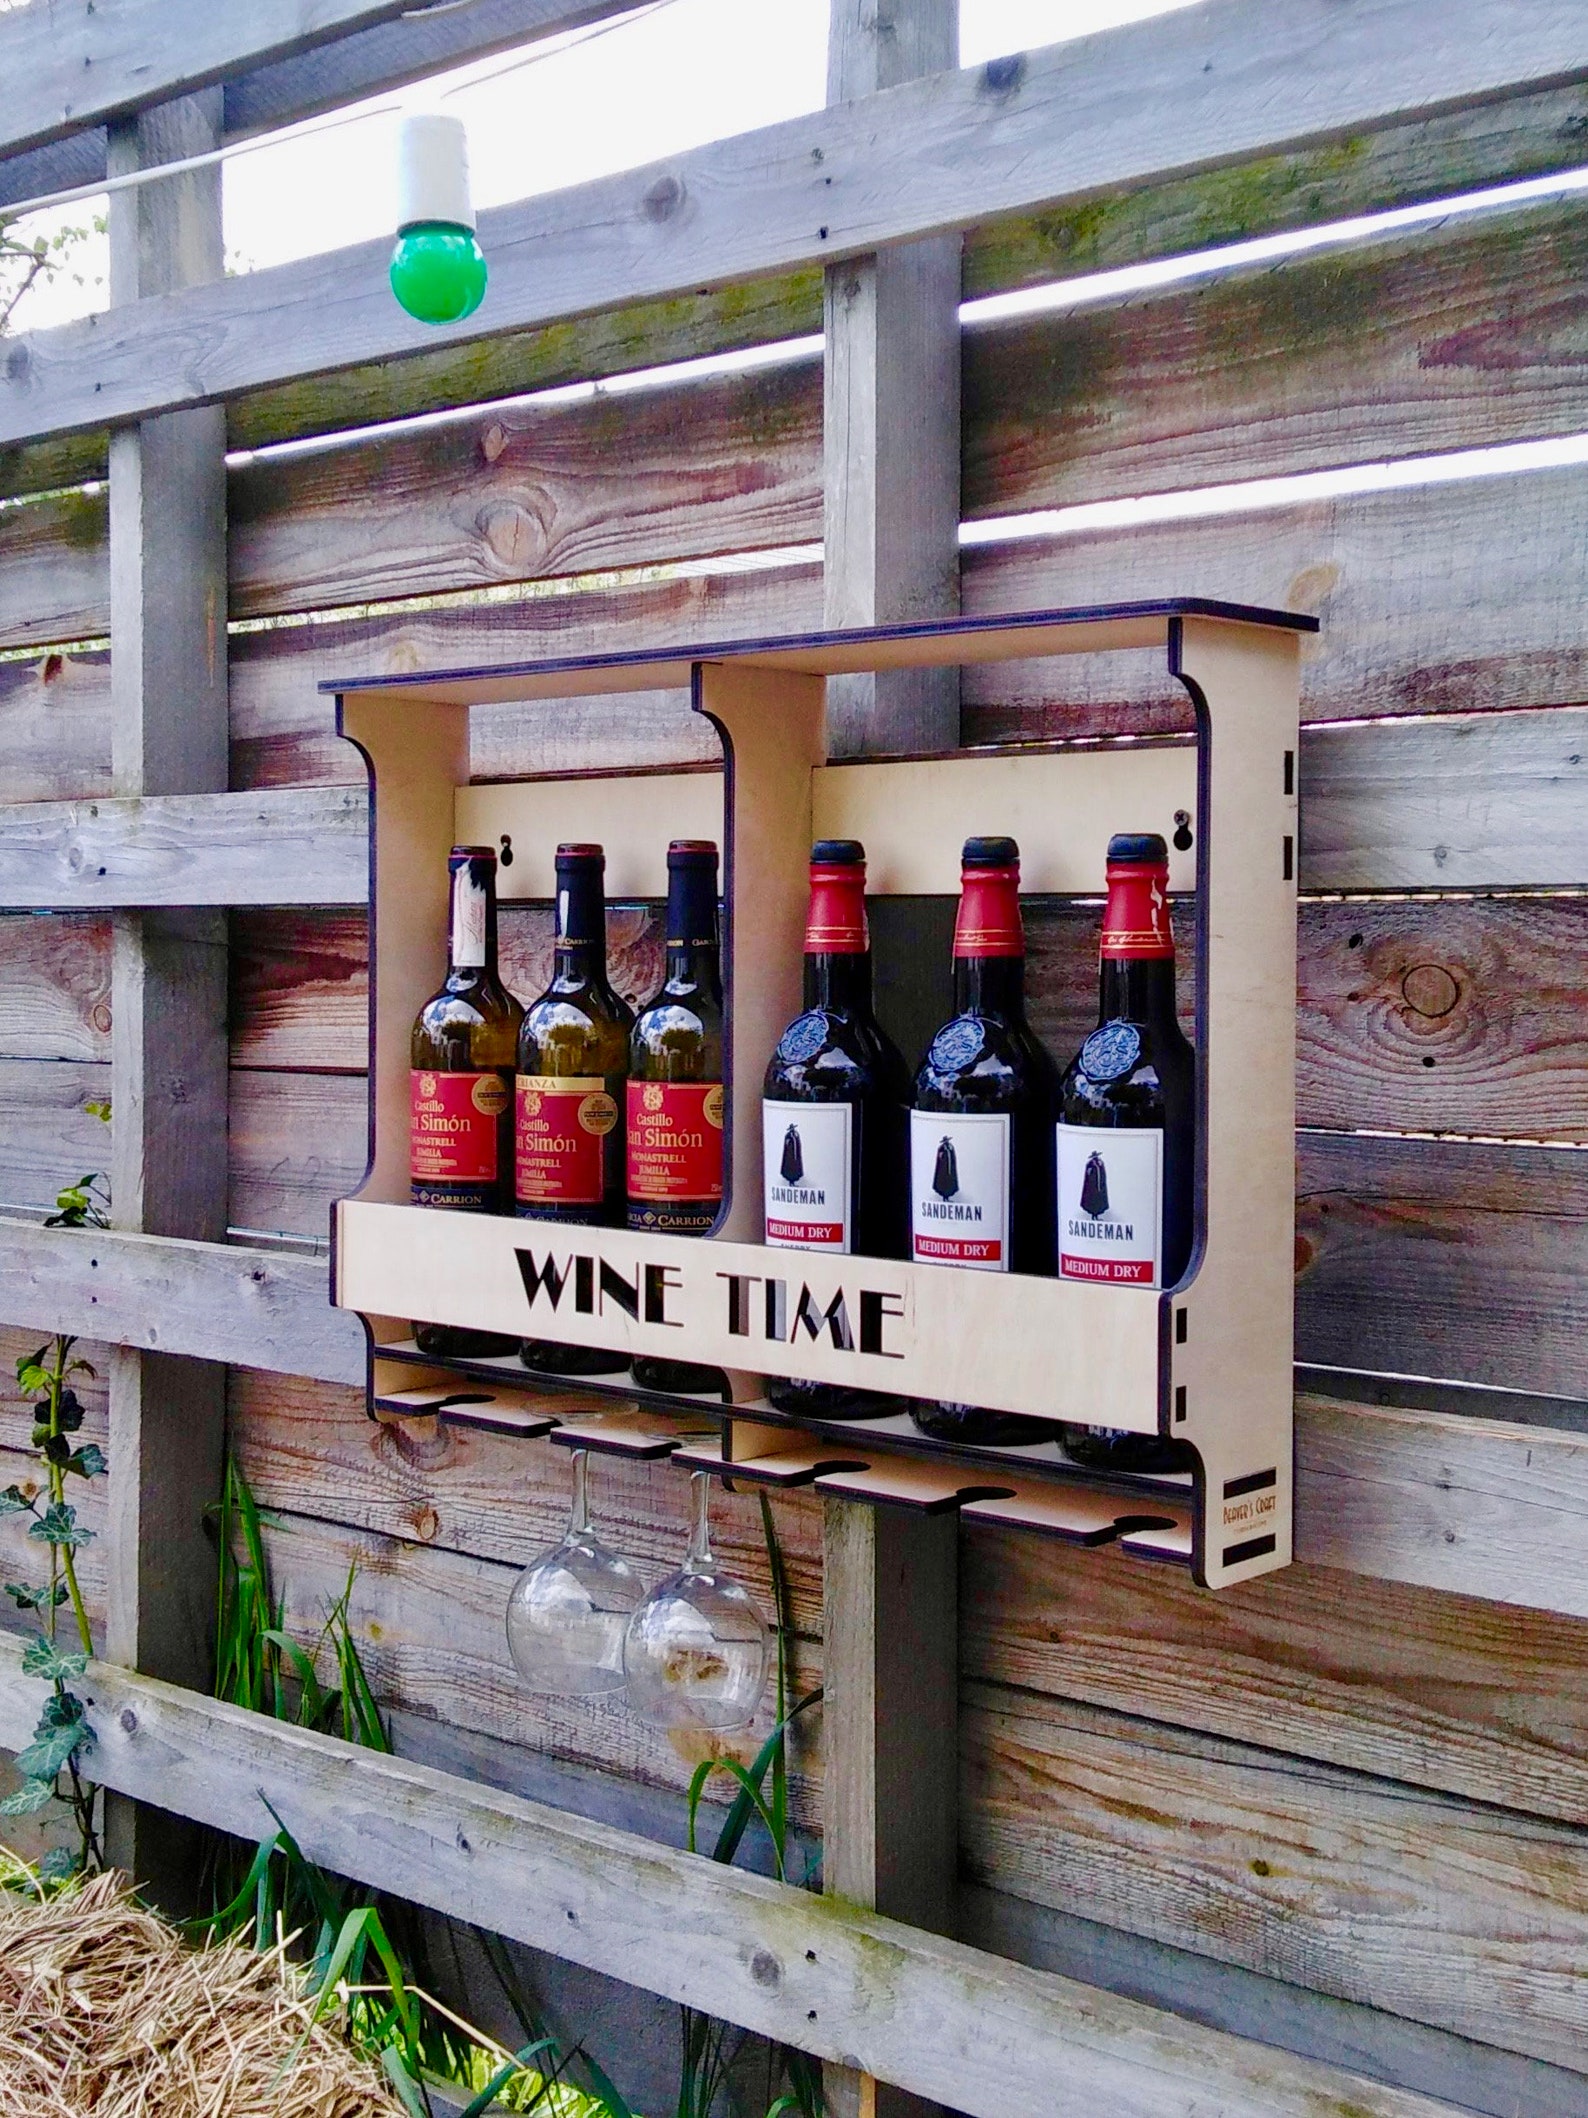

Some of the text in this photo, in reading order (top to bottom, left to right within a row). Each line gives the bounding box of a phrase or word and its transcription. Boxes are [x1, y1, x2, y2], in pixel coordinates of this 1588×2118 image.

[414, 1100, 445, 1113] Castillo
[421, 1113, 471, 1132] Simón
[520, 1119, 549, 1132] Castillo
[636, 1113, 673, 1126] Castillo
[526, 1133, 577, 1153] Simón
[645, 1128, 703, 1147] Simón
[431, 1193, 482, 1204] CARRION
[771, 1186, 825, 1205] SANDEMAN
[658, 1214, 714, 1226] CARRION
[922, 1202, 982, 1221] SANDEMAN
[769, 1222, 833, 1239] MEDIUM DRY
[1068, 1219, 1134, 1241] SANDEMAN
[918, 1239, 990, 1256] MEDIUM DRY
[1065, 1258, 1142, 1278] MEDIUM DRY
[513, 1247, 905, 1360] WINE TIME
